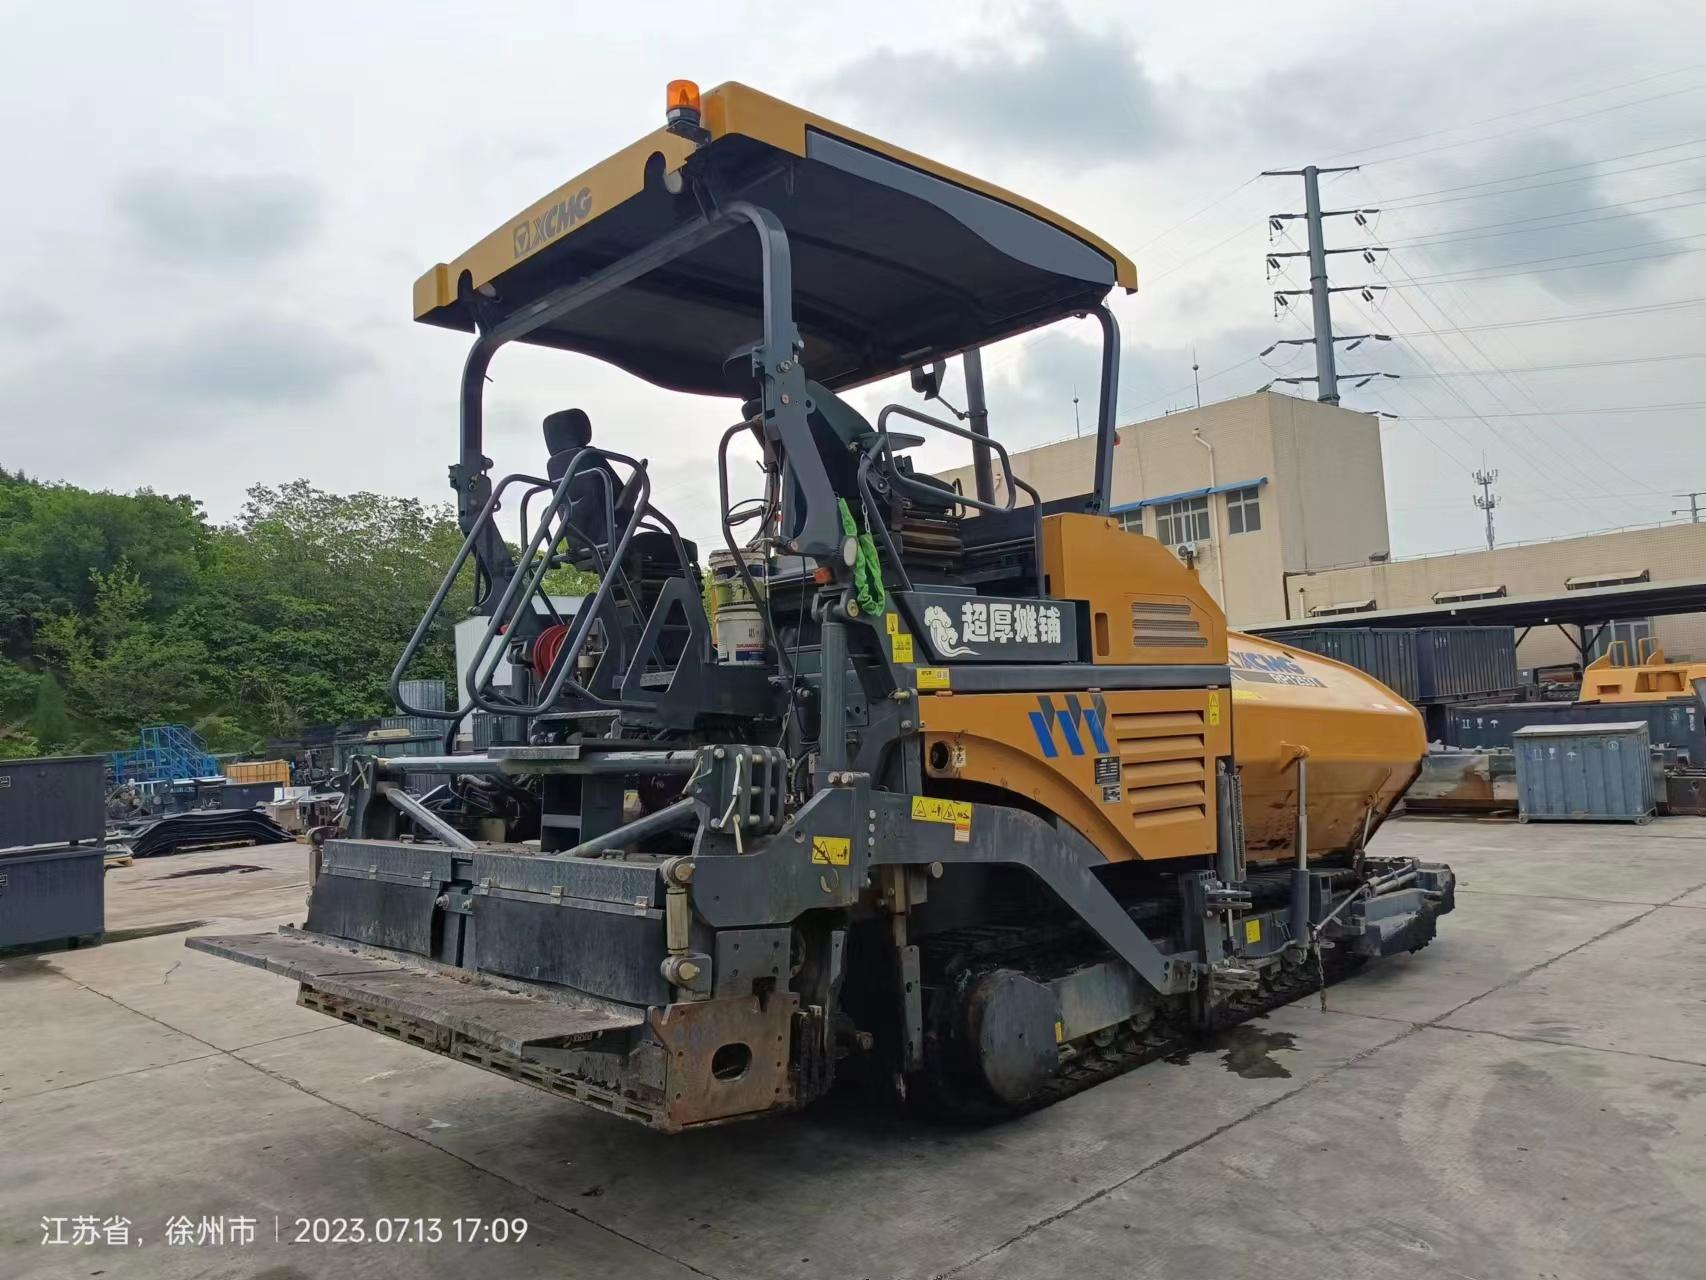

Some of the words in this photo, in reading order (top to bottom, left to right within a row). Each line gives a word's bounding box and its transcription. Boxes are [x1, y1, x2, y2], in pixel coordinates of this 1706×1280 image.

[531, 187, 593, 247] XCMG
[961, 601, 1061, 643] 超厚摊铺
[1236, 652, 1305, 674] XCMG
